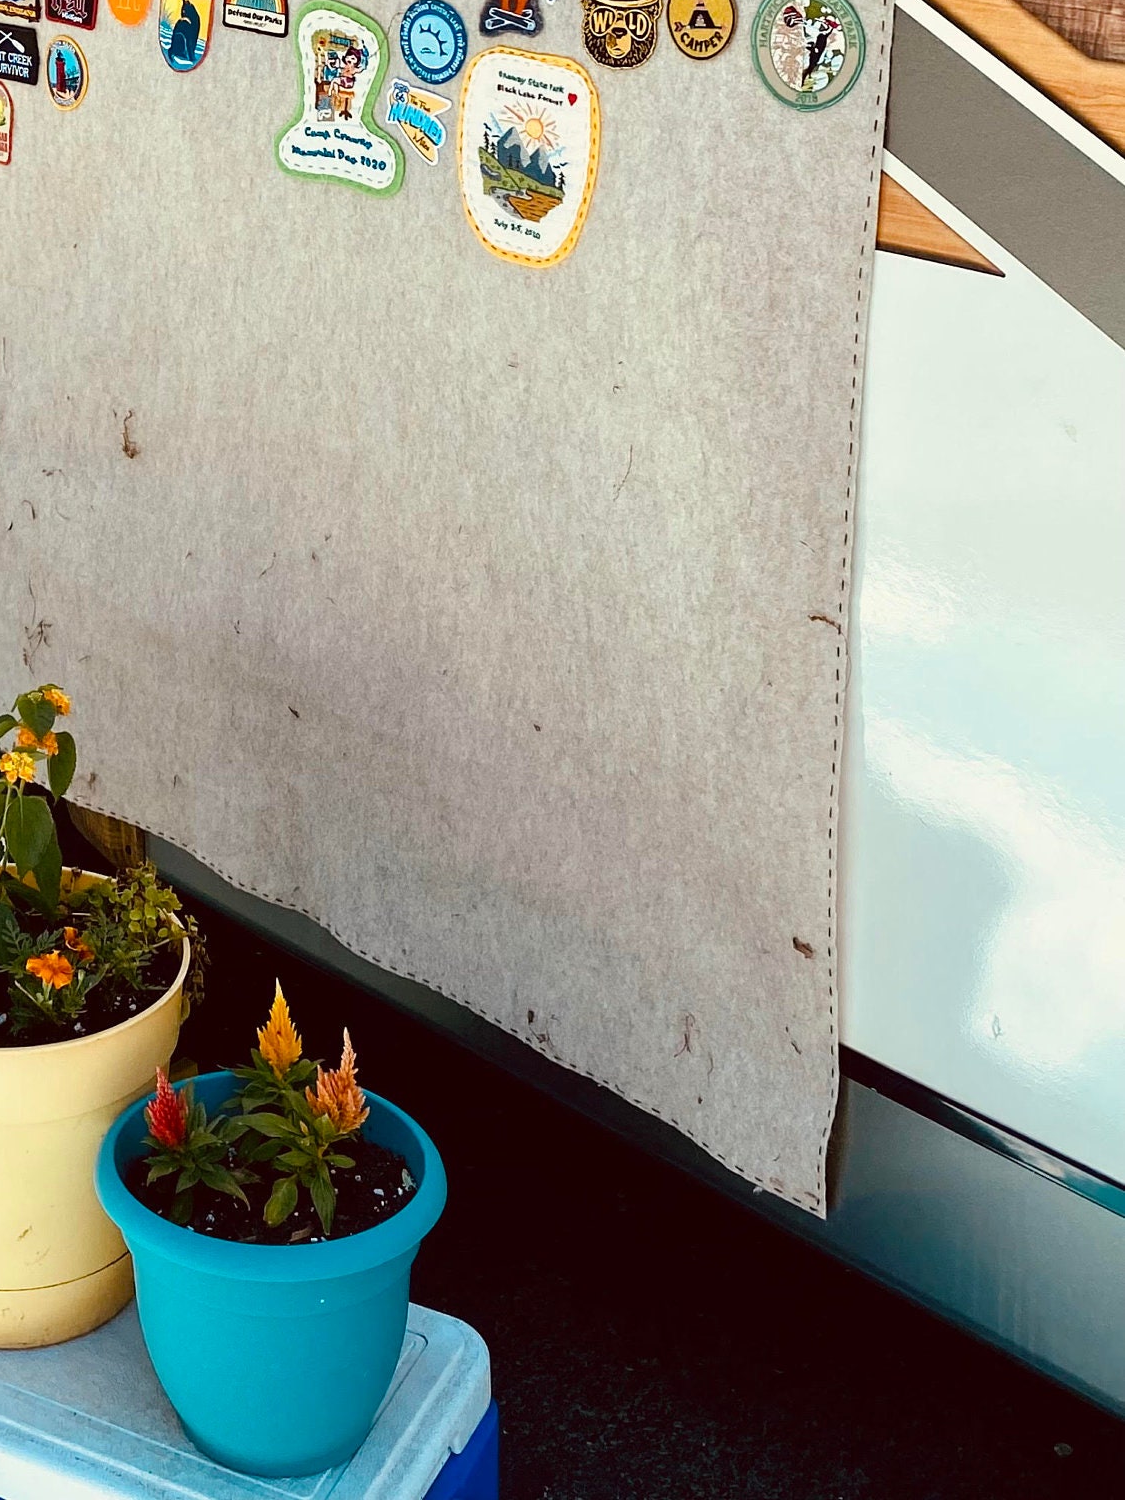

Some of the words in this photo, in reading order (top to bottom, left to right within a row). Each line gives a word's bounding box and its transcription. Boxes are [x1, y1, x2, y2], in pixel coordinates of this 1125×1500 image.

[228, 9, 251, 19] Defend
[252, 13, 264, 21] Our
[264, 15, 282, 25] Parks
[680, 31, 724, 53] CAMPER
[7, 52, 33, 67] CREEK
[497, 84, 517, 95] Black
[528, 79, 548, 90] State
[395, 92, 406, 102] 66
[304, 126, 331, 140] Camp
[361, 156, 387, 171] 2020
